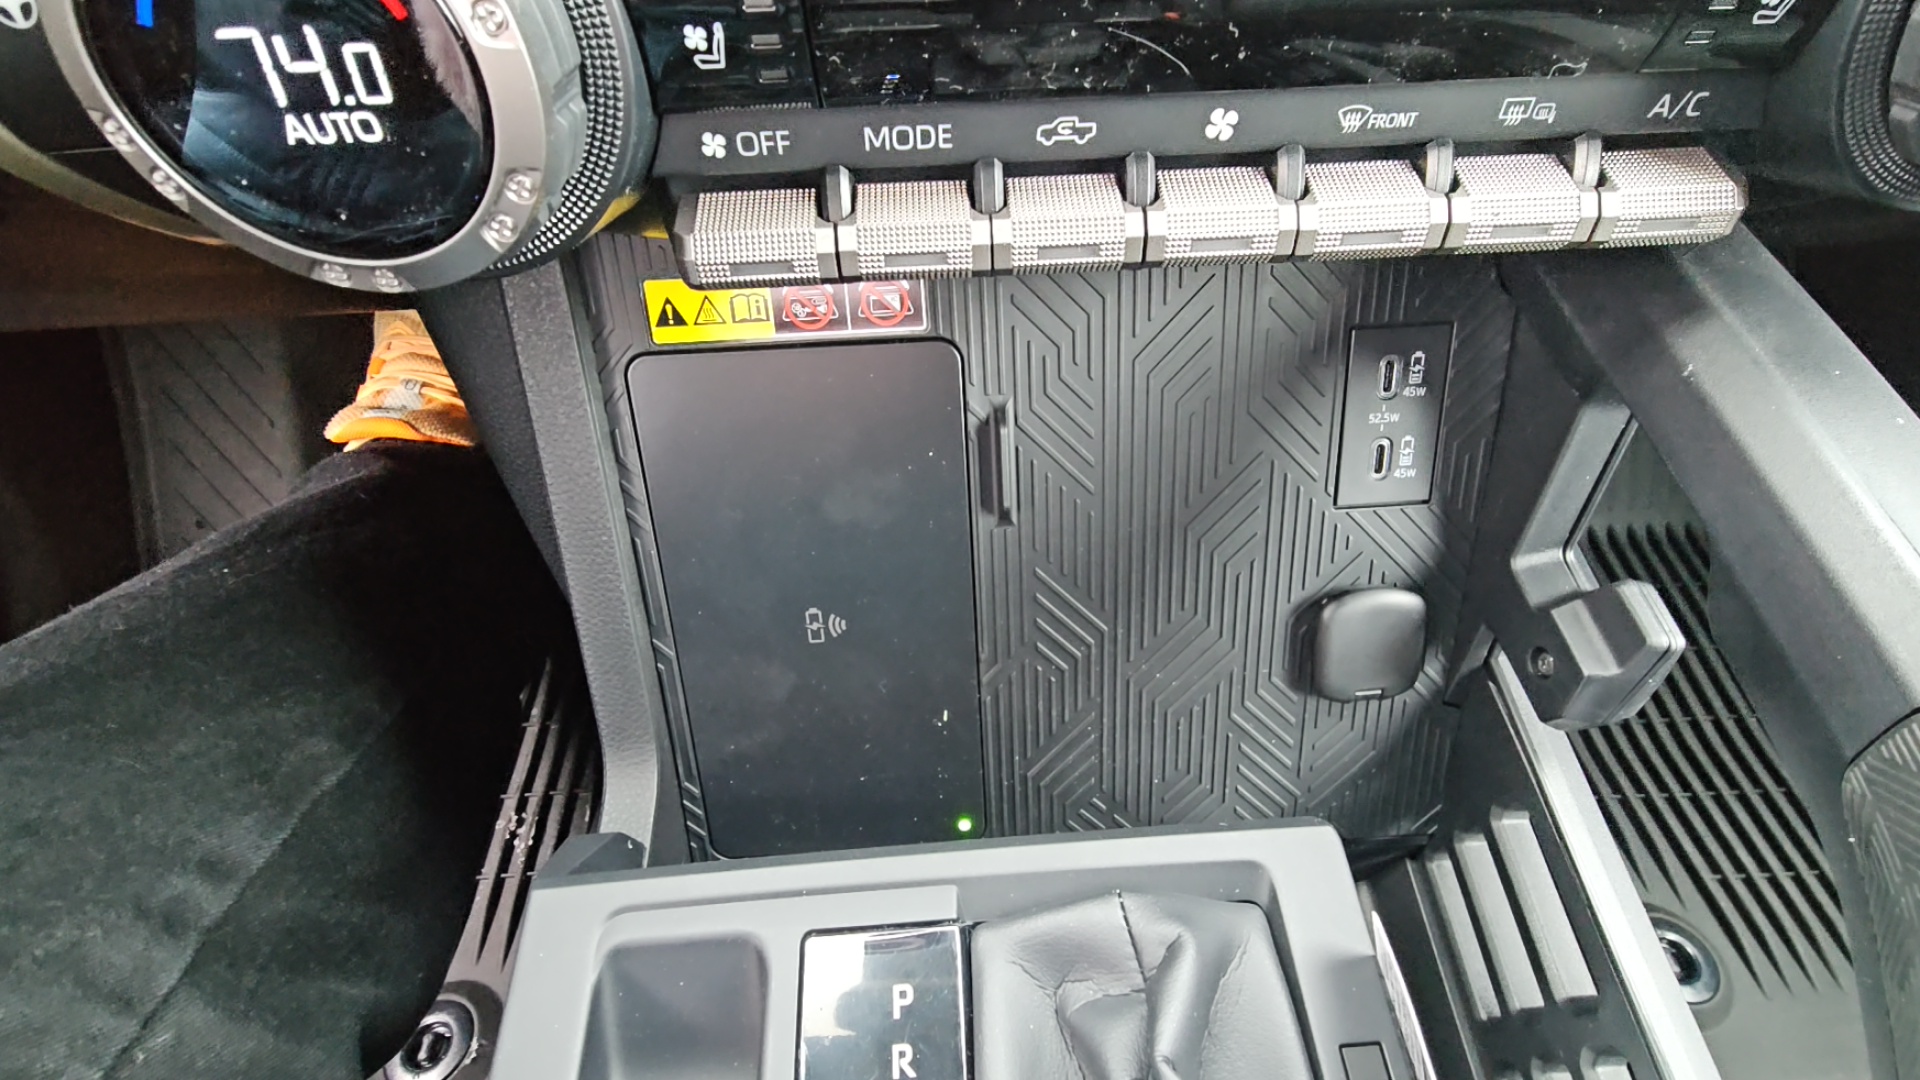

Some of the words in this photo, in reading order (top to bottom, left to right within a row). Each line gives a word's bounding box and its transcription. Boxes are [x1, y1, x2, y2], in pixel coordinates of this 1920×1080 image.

[214, 24, 394, 108] 74.0
[1646, 91, 1710, 119] A/C
[284, 110, 384, 146] AUTO
[1368, 111, 1419, 129] FRONT
[736, 130, 791, 157] OFF
[863, 124, 953, 151] MODE
[1402, 386, 1426, 397] 45W
[1368, 413, 1400, 424] 52.5W
[1393, 468, 1416, 478] 45W
[892, 983, 914, 1020] P
[891, 1043, 917, 1080] R
